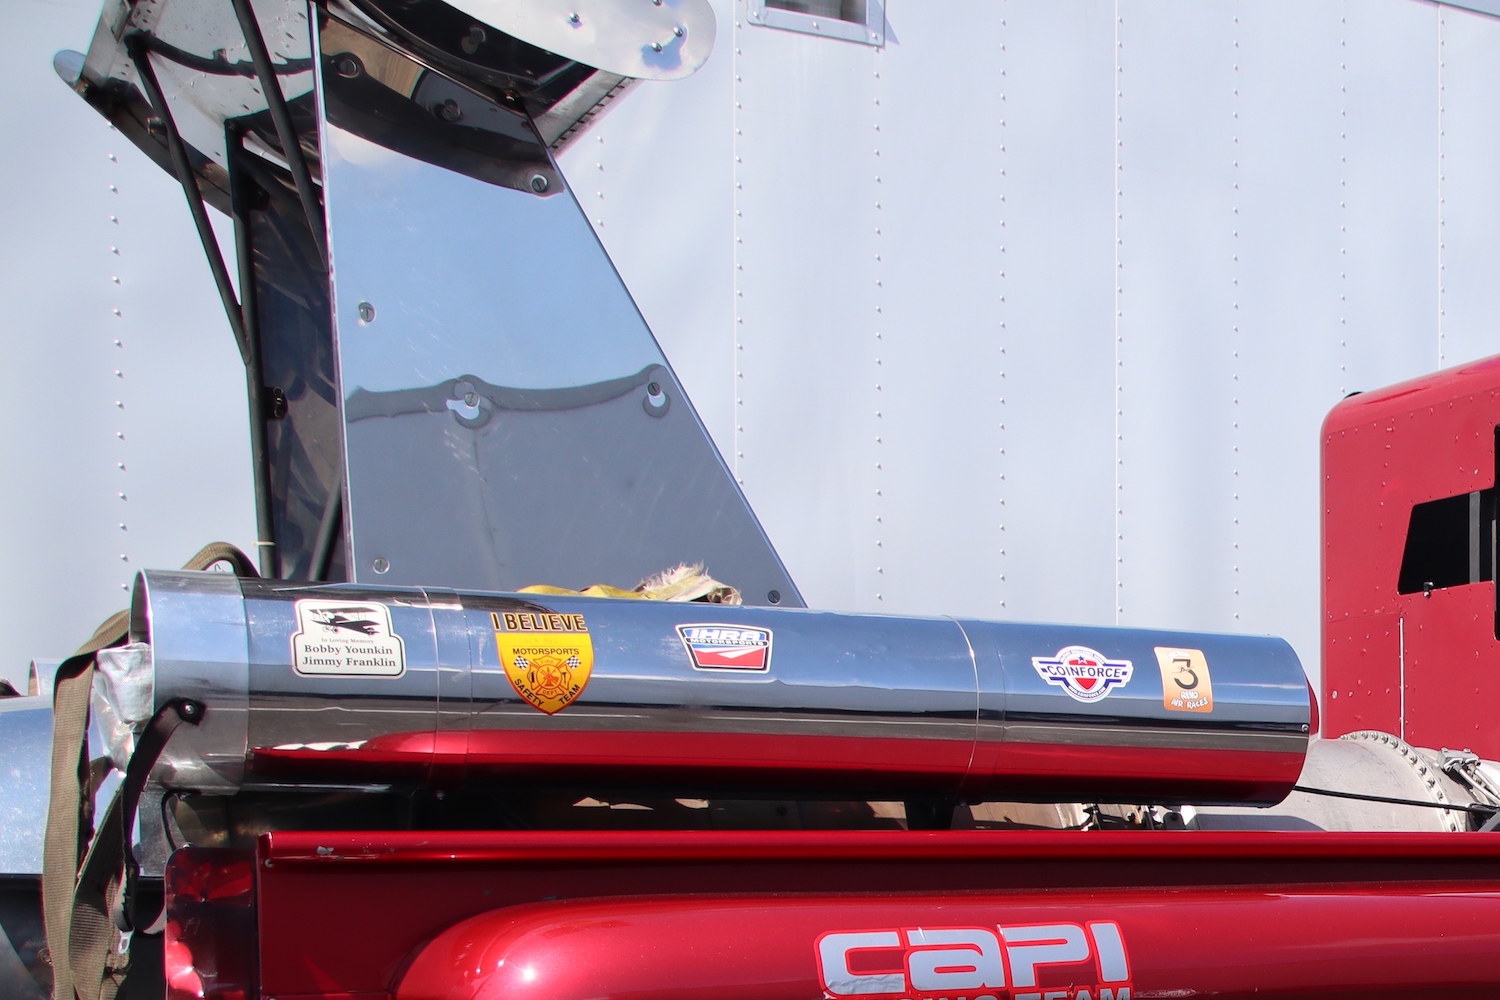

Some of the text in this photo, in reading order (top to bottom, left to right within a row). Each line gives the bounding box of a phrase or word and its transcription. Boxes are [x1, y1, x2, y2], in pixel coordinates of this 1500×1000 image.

[490, 612, 588, 631] I BELIEVE
[690, 628, 760, 641] IHRA
[690, 638, 764, 646] MOTORSPORTS
[304, 644, 393, 655] Bobby Younkin
[512, 647, 580, 655] MOTORSPORTS
[302, 656, 396, 667] Jimmy Franklin
[1046, 665, 1121, 678] COINFORCE
[514, 678, 580, 707] SAFETY TEAM
[1180, 691, 1199, 700] RENO
[1171, 697, 1208, 709] AIR RACES
